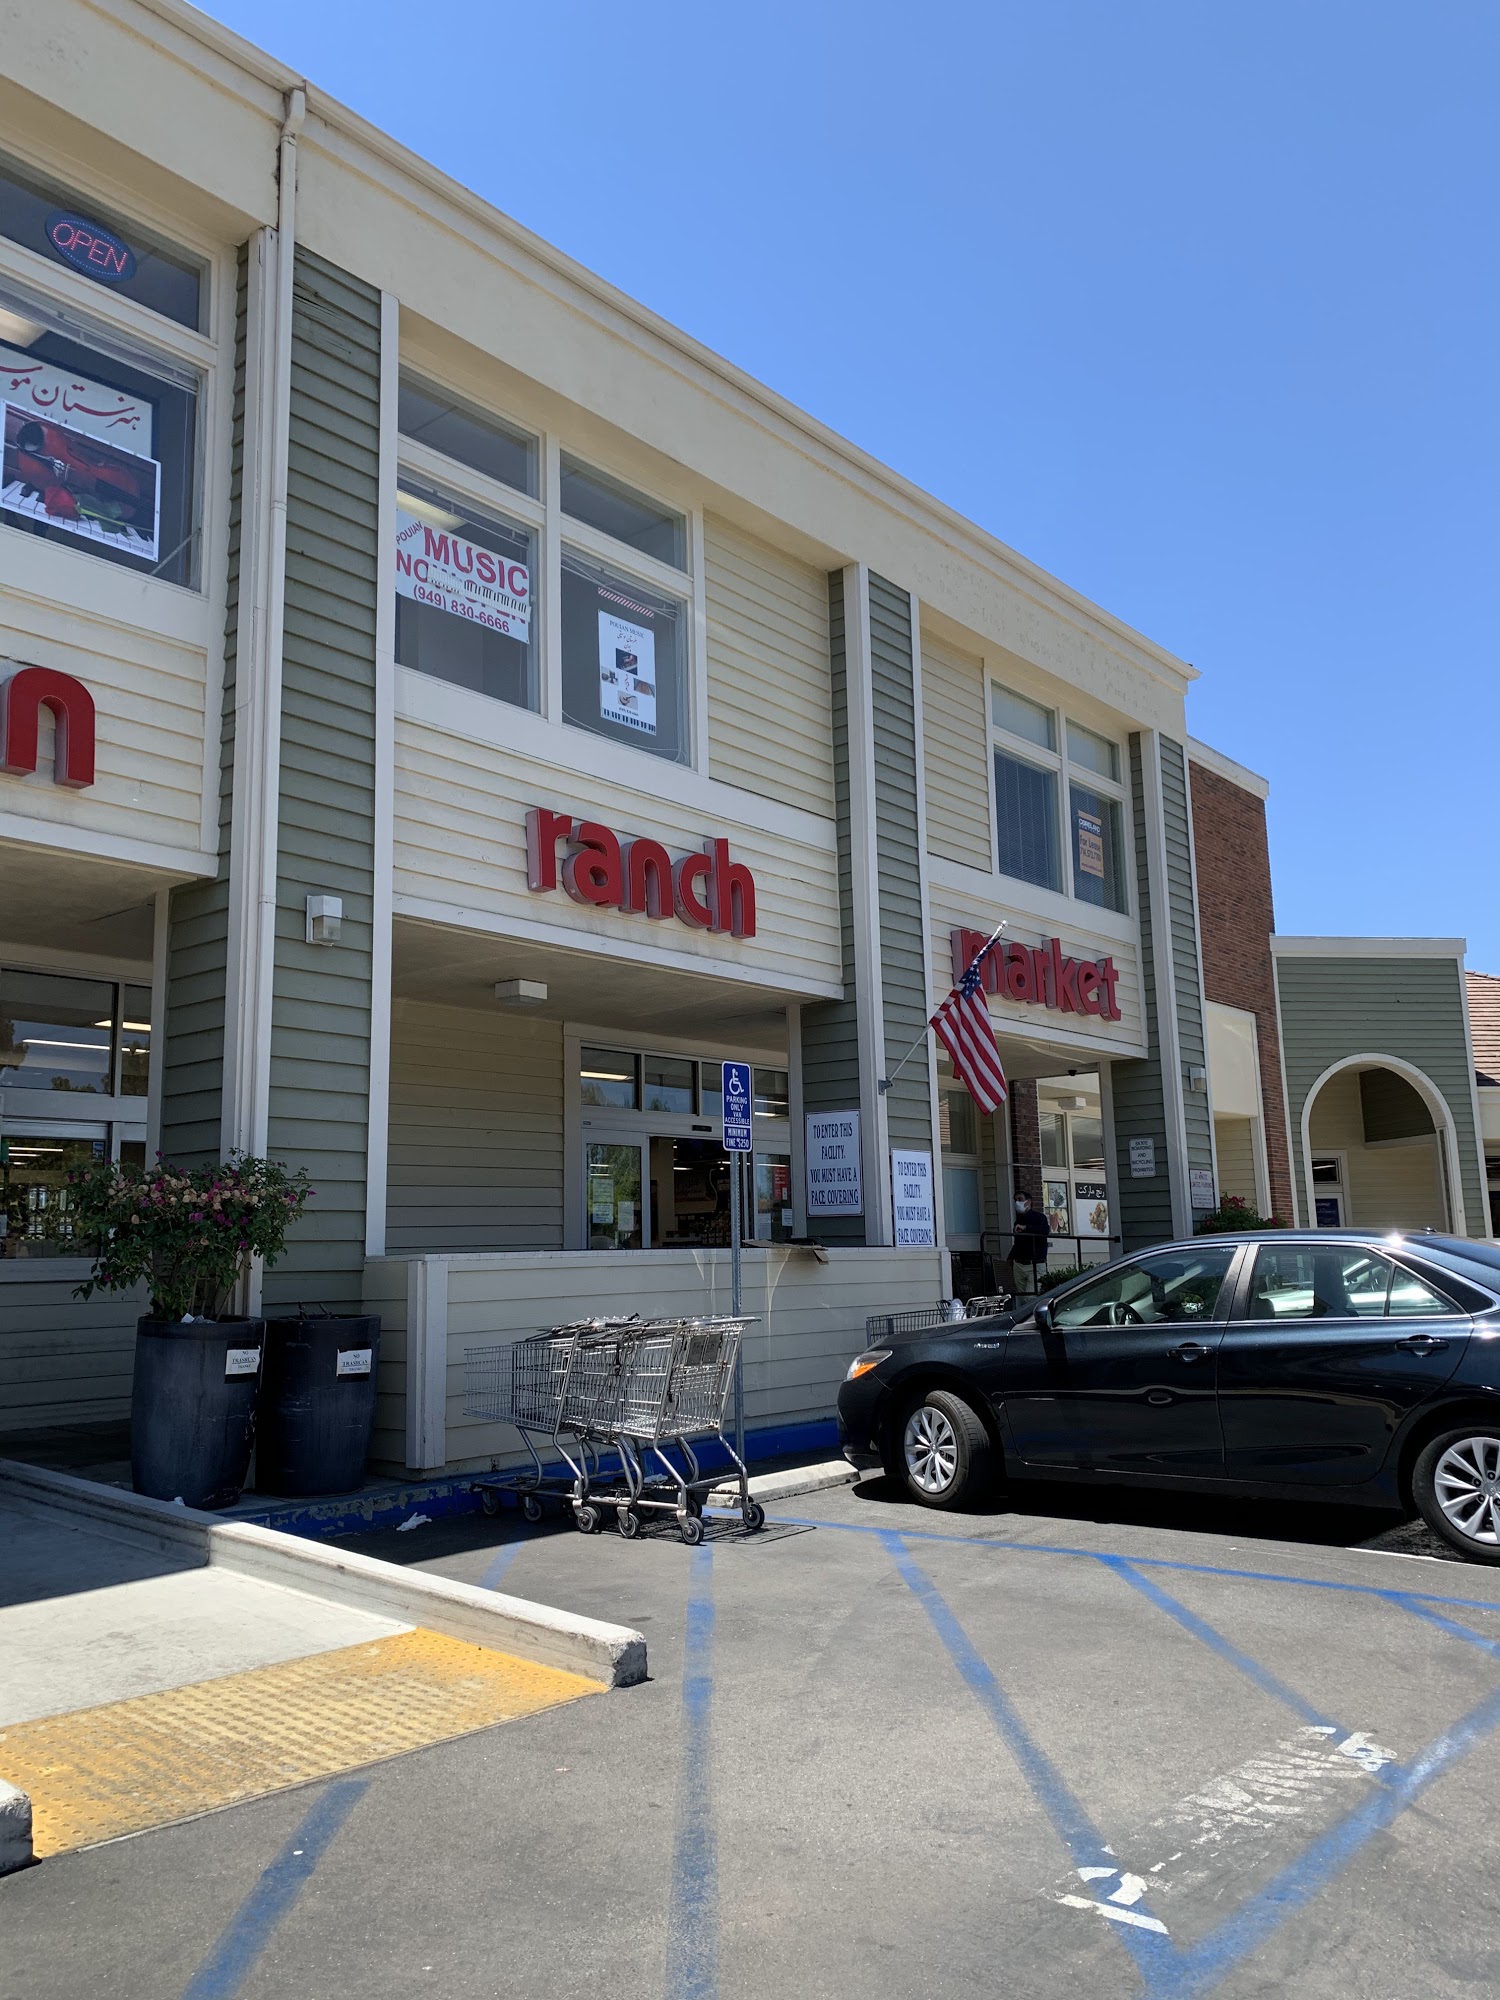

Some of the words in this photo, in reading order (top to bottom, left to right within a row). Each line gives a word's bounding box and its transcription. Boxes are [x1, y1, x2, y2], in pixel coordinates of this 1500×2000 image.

[53, 223, 128, 273] OPEN
[424, 526, 528, 597] MUSIC
[413, 584, 447, 610] (949)
[450, 599, 510, 633] 830-6666
[525, 808, 756, 939] ranch
[951, 929, 1122, 1022] market
[726, 1095, 748, 1104] PARKING
[730, 1103, 744, 1112] ONLY
[724, 1116, 750, 1125] ACCESSIBLE
[727, 1127, 748, 1138] MINIMUM
[813, 1124, 821, 1139] TO
[821, 1123, 839, 1139] ENTER
[839, 1122, 853, 1138] THIS
[725, 1137, 736, 1147] FINE
[736, 1138, 750, 1149] $250
[810, 1168, 820, 1184] YOU
[821, 1167, 836, 1183] MUST
[837, 1167, 852, 1183] HAVE
[853, 1167, 858, 1182] A
[897, 1161, 903, 1176] TO
[903, 1161, 917, 1177] ENTER
[917, 1162, 927, 1177] THIS
[811, 1190, 826, 1205] FACE
[827, 1188, 859, 1205] COVERING
[897, 1205, 905, 1221] YOU
[905, 1206, 916, 1221] MUST
[916, 1206, 927, 1221] HAVE
[927, 1207, 931, 1221] A
[898, 1228, 909, 1243] FACE
[909, 1228, 932, 1244] COVERING
